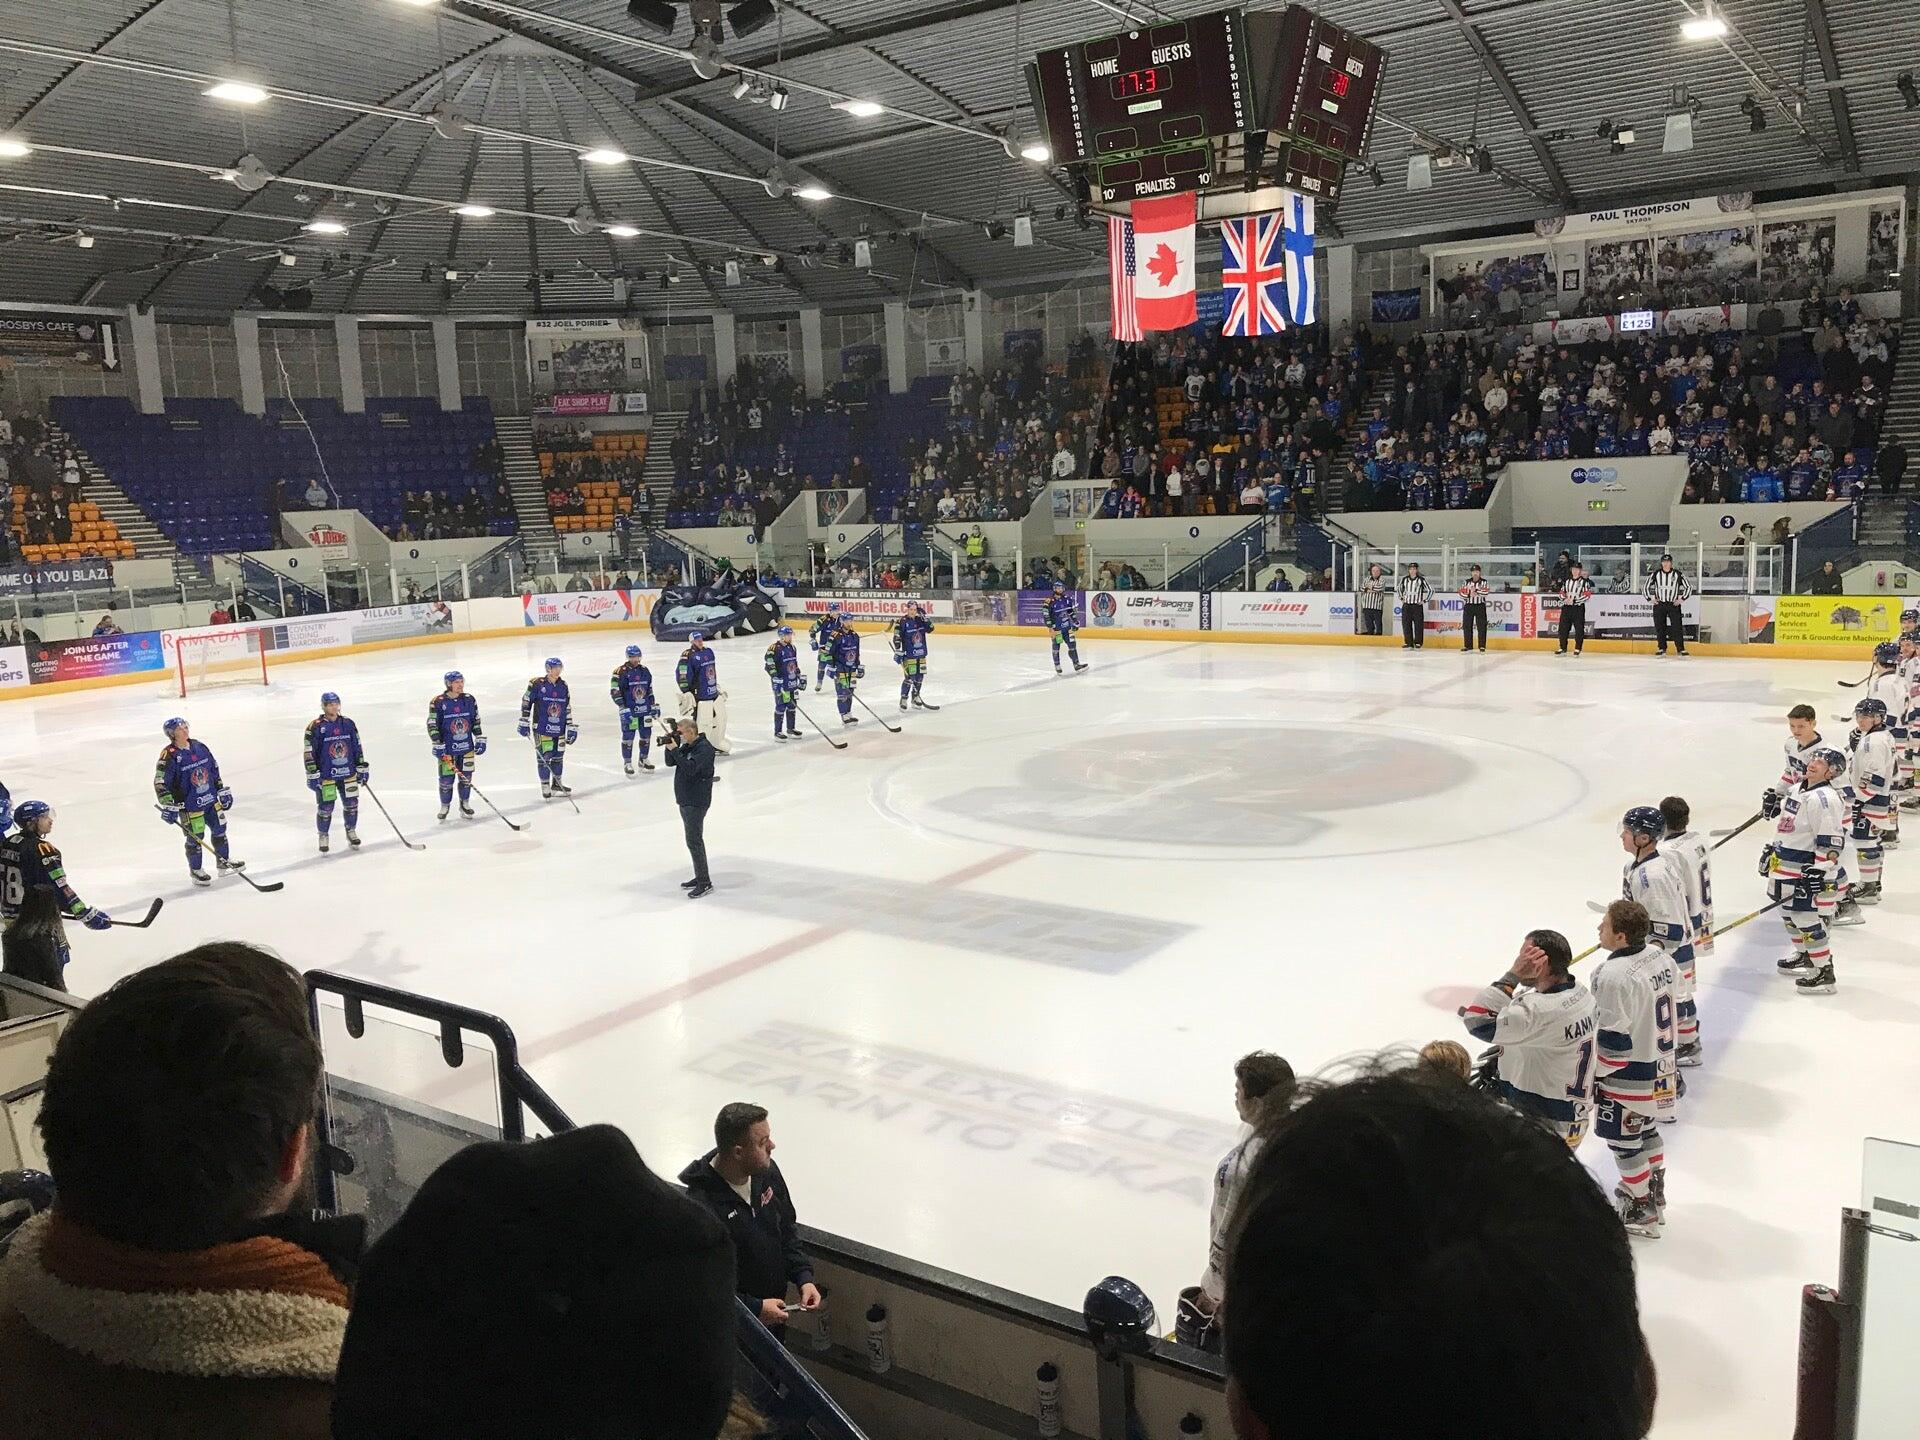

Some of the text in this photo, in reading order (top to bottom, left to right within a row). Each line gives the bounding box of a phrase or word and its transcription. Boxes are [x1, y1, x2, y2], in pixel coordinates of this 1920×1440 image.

[1224, 15, 1230, 23] 4
[1225, 25, 1231, 33] 5
[1226, 34, 1232, 43] 6
[1228, 44, 1233, 52] 7
[1151, 43, 1192, 65] GUESTS
[1229, 54, 1235, 62] 8
[1065, 60, 1070, 68] 5
[1090, 59, 1119, 78] HOME
[1230, 63, 1236, 71] 9
[1066, 69, 1072, 77] 6
[1230, 72, 1239, 80] 10
[1068, 78, 1072, 86] 7
[1231, 82, 1239, 90] 11
[1069, 87, 1075, 95] 8
[1232, 91, 1240, 99] 12
[1070, 95, 1076, 103] 9
[1071, 104, 1079, 112] 10
[1233, 101, 1241, 109] 13
[1072, 113, 1080, 121] 11
[1235, 110, 1243, 118] 14
[1073, 122, 1081, 130] 12
[1236, 119, 1244, 127] 15
[1075, 131, 1082, 139] 13
[1135, 177, 1176, 195] PENALTIES
[1301, 175, 1321, 192] PENALTIES
[1590, 202, 1691, 223] PAUL THOMPSON
[46, 322, 76, 332] CAFE
[553, 320, 574, 328] JOEL
[1622, 319, 1651, 329] £125
[44, 570, 69, 583] YOU
[898, 591, 921, 599] BLAZE
[1126, 597, 1153, 607] USA
[1440, 600, 1464, 611] MID
[362, 607, 403, 619] VILLAGE
[538, 605, 557, 614] INLINE
[1201, 593, 1210, 630] Reebok
[1779, 610, 1820, 618] Agricultural
[539, 613, 560, 622] FIGURE
[1524, 595, 1534, 636] Reebok
[289, 623, 327, 633] COVENTRY
[161, 628, 242, 650] RAMADA
[289, 631, 319, 640] SLIDING
[1809, 634, 1850, 642] Groundcare
[1852, 634, 1892, 643] Machinery
[289, 637, 335, 648] WARDROBES
[62, 641, 129, 656] JOIN US AFTER
[74, 651, 121, 663] THE GAME
[31, 659, 59, 668] GENTING
[34, 666, 58, 674] CASINO
[1655, 992, 1674, 1054] 9
[680, 1047, 912, 1122] LEARN
[923, 1110, 1023, 1151] TO
